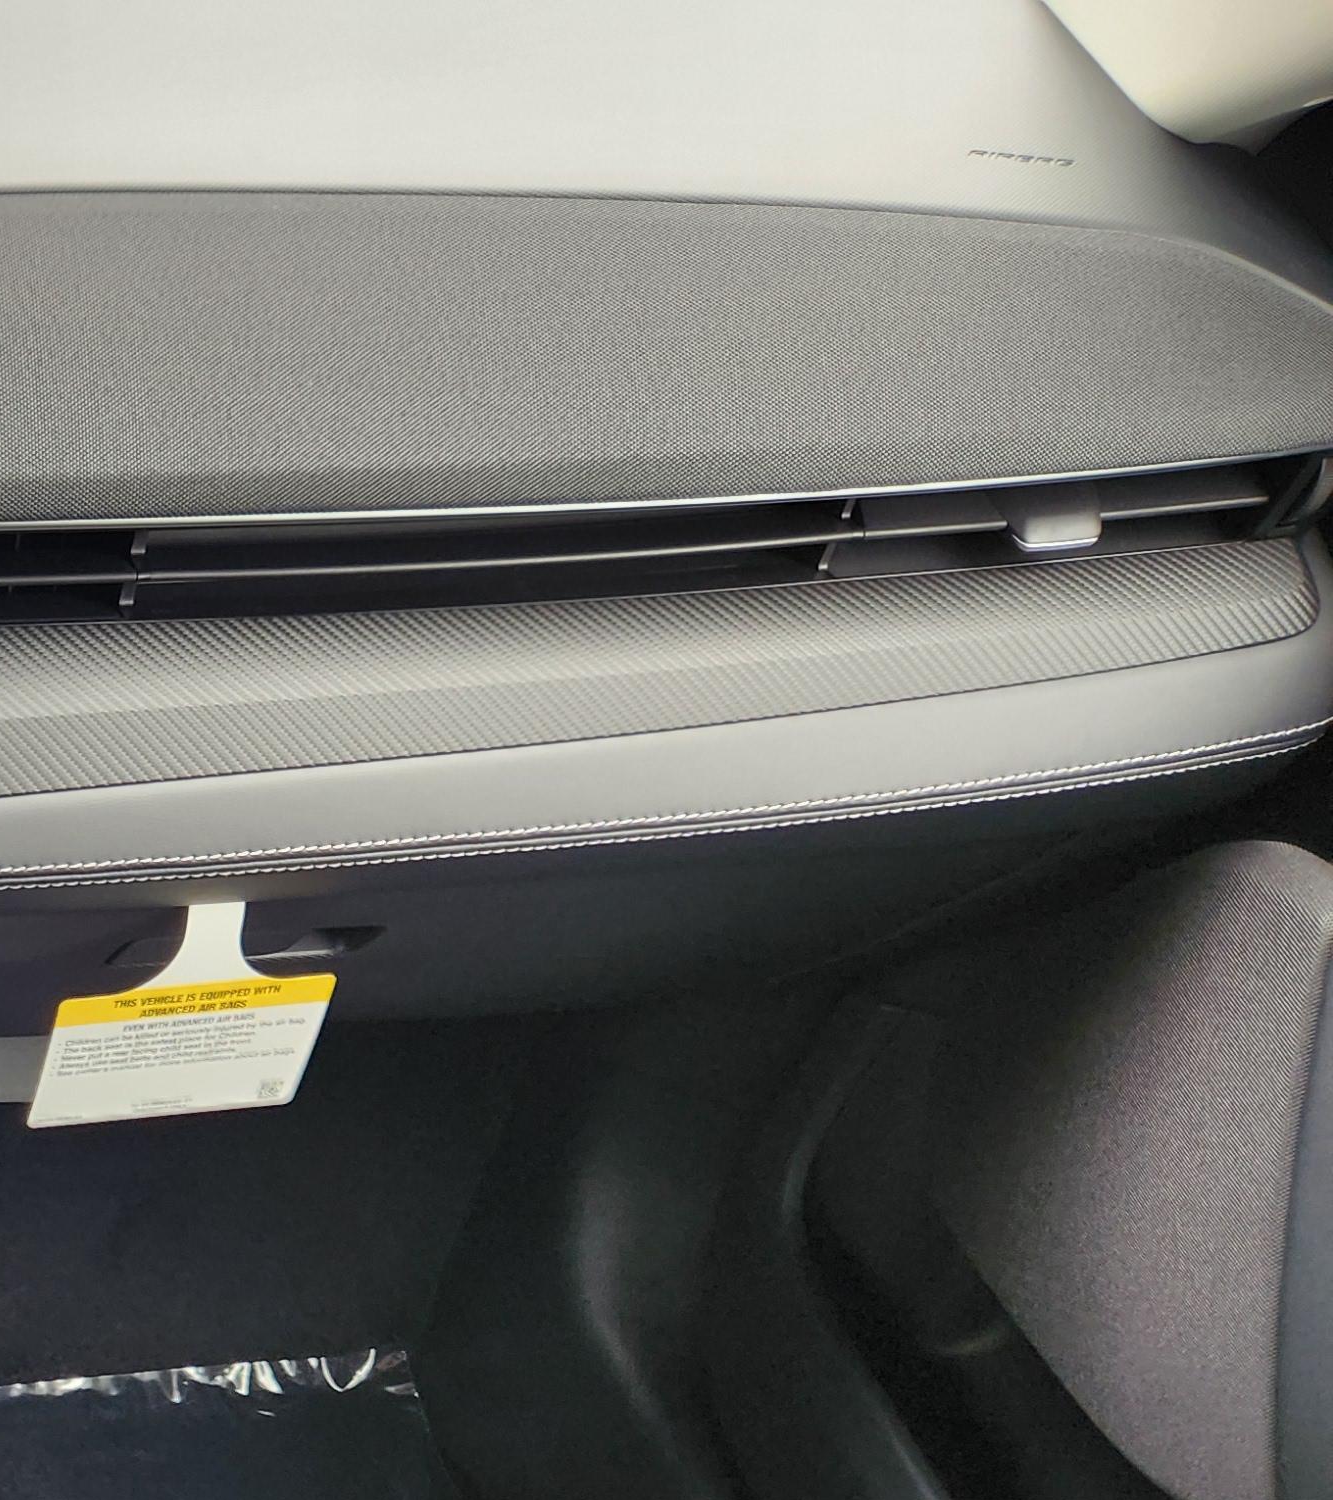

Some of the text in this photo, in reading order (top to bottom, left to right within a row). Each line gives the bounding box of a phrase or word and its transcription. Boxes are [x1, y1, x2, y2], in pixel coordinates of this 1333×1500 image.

[967, 149, 1075, 167] AIRBAG
[113, 985, 281, 1008] THIS VEHICLE IS EQUIPPED WITH
[139, 1000, 246, 1017] ADVANCED AIR BAGS
